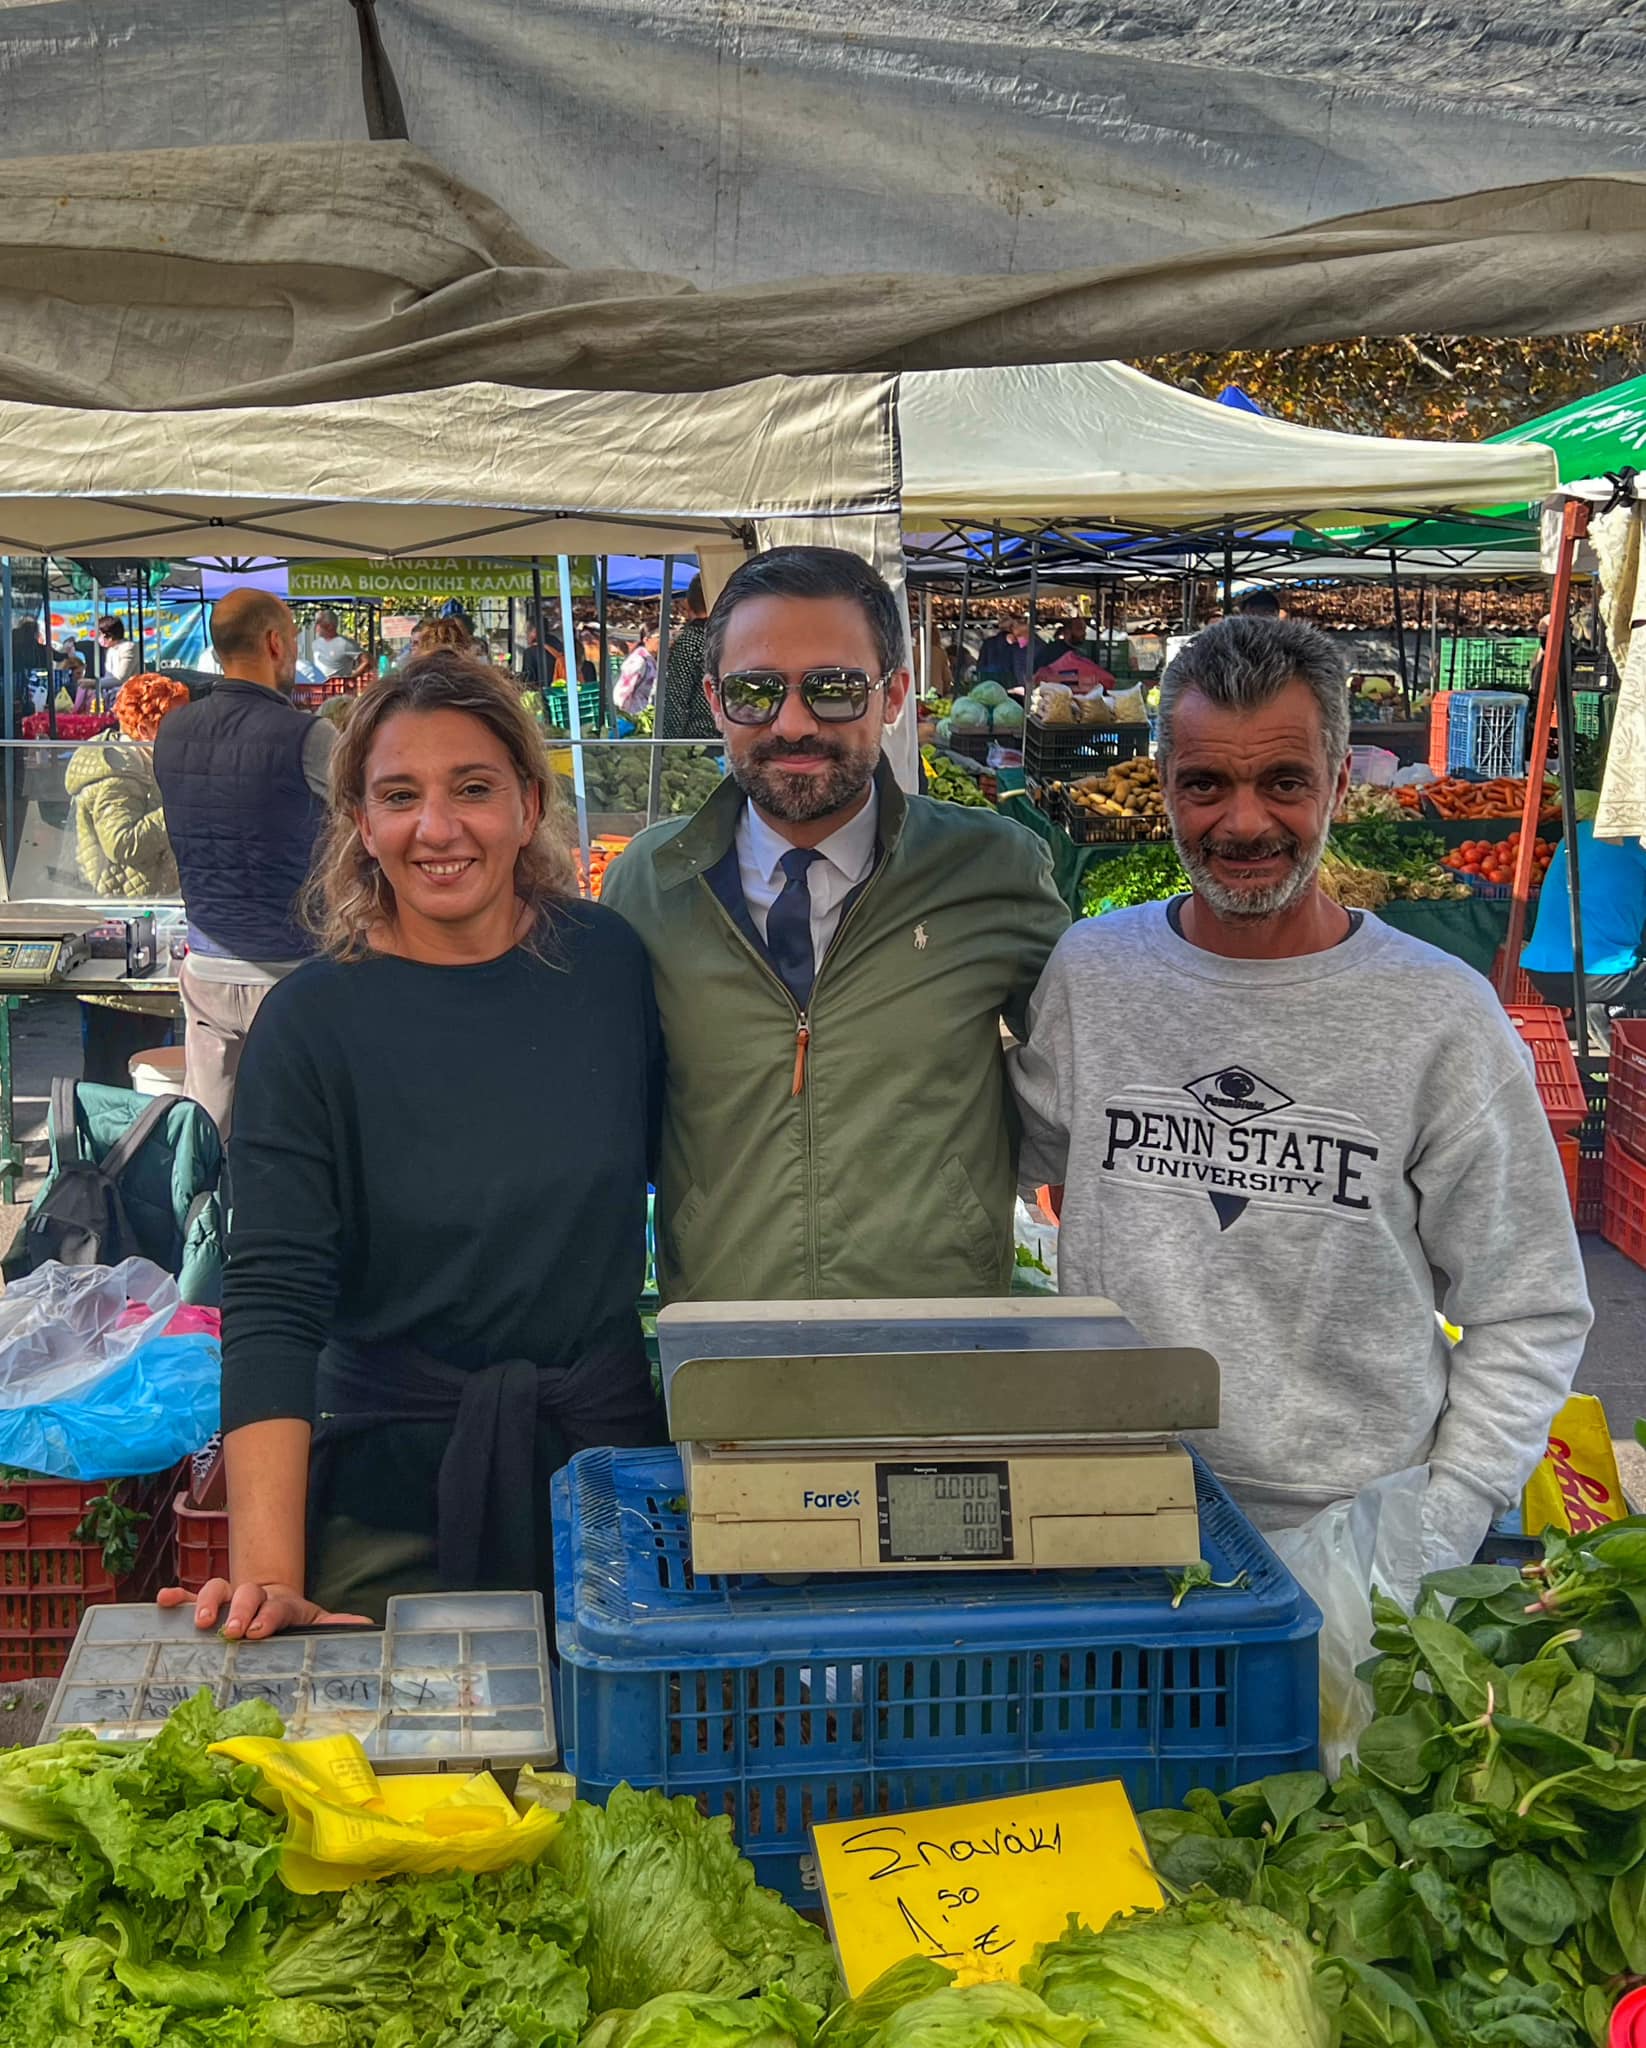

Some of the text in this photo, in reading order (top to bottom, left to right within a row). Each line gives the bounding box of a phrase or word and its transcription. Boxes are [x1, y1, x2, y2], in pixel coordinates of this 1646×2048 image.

[291, 574, 352, 590] ΚΤΗΜΑ
[359, 575, 465, 591] ΒΙΟΛΟΓΙΚΗΣ
[1102, 1108, 1379, 1210] PENN STATE
[1136, 1154, 1323, 1197] UNIVERSITY
